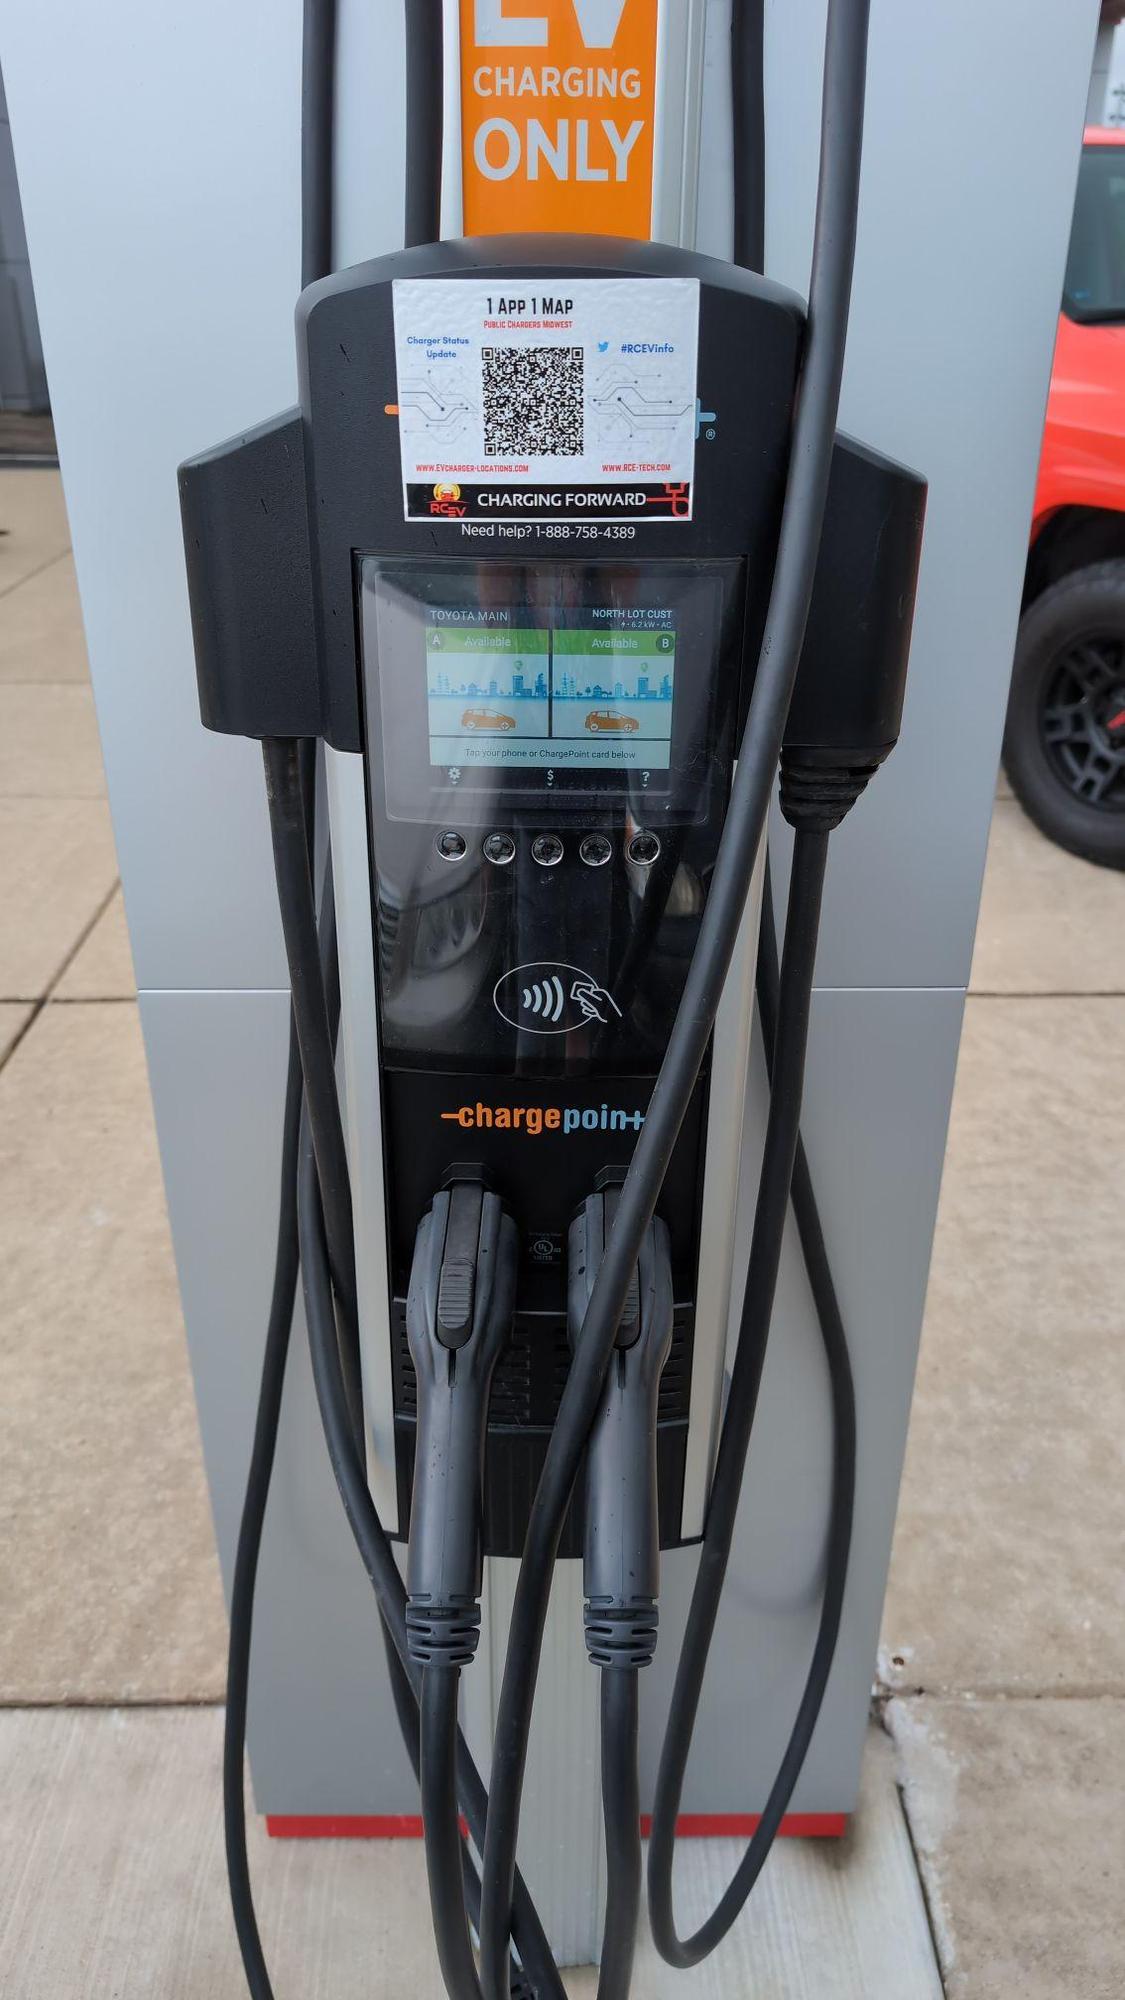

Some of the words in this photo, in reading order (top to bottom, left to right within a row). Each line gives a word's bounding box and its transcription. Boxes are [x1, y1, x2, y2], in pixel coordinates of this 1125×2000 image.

[473, 67, 640, 98] CHARGING
[473, 117, 645, 182] ONLY
[487, 297, 492, 315] 1
[498, 297, 526, 315] APP
[531, 297, 537, 315] 1
[542, 297, 573, 315] MAP
[483, 320, 506, 329] PUBLIC
[507, 320, 541, 329] CHARGERS
[542, 320, 573, 329] MIDWEST
[407, 336, 441, 346] Charger
[442, 336, 470, 345] Status
[621, 343, 674, 354] #RCEVinfo
[426, 350, 457, 359] Update
[477, 492, 561, 507] CHARGING
[565, 492, 647, 507] FORWARD
[461, 524, 494, 537] Need
[498, 525, 532, 538] help?
[535, 526, 636, 539] 1-888-758-4389
[430, 610, 475, 621] TOYOTA
[478, 611, 508, 621] MAIN
[592, 609, 625, 618] NORTH
[627, 609, 645, 618] LOT
[647, 609, 673, 619] CUST
[661, 621, 672, 629] AC
[432, 635, 441, 645] A
[464, 636, 512, 647] Available
[592, 638, 638, 649] Available
[662, 638, 670, 649] B
[465, 748, 481, 757] Tap
[482, 750, 500, 758] your
[501, 749, 527, 758] phone
[539, 749, 590, 759] ChargePoint
[591, 750, 610, 759] card
[611, 750, 636, 759] below
